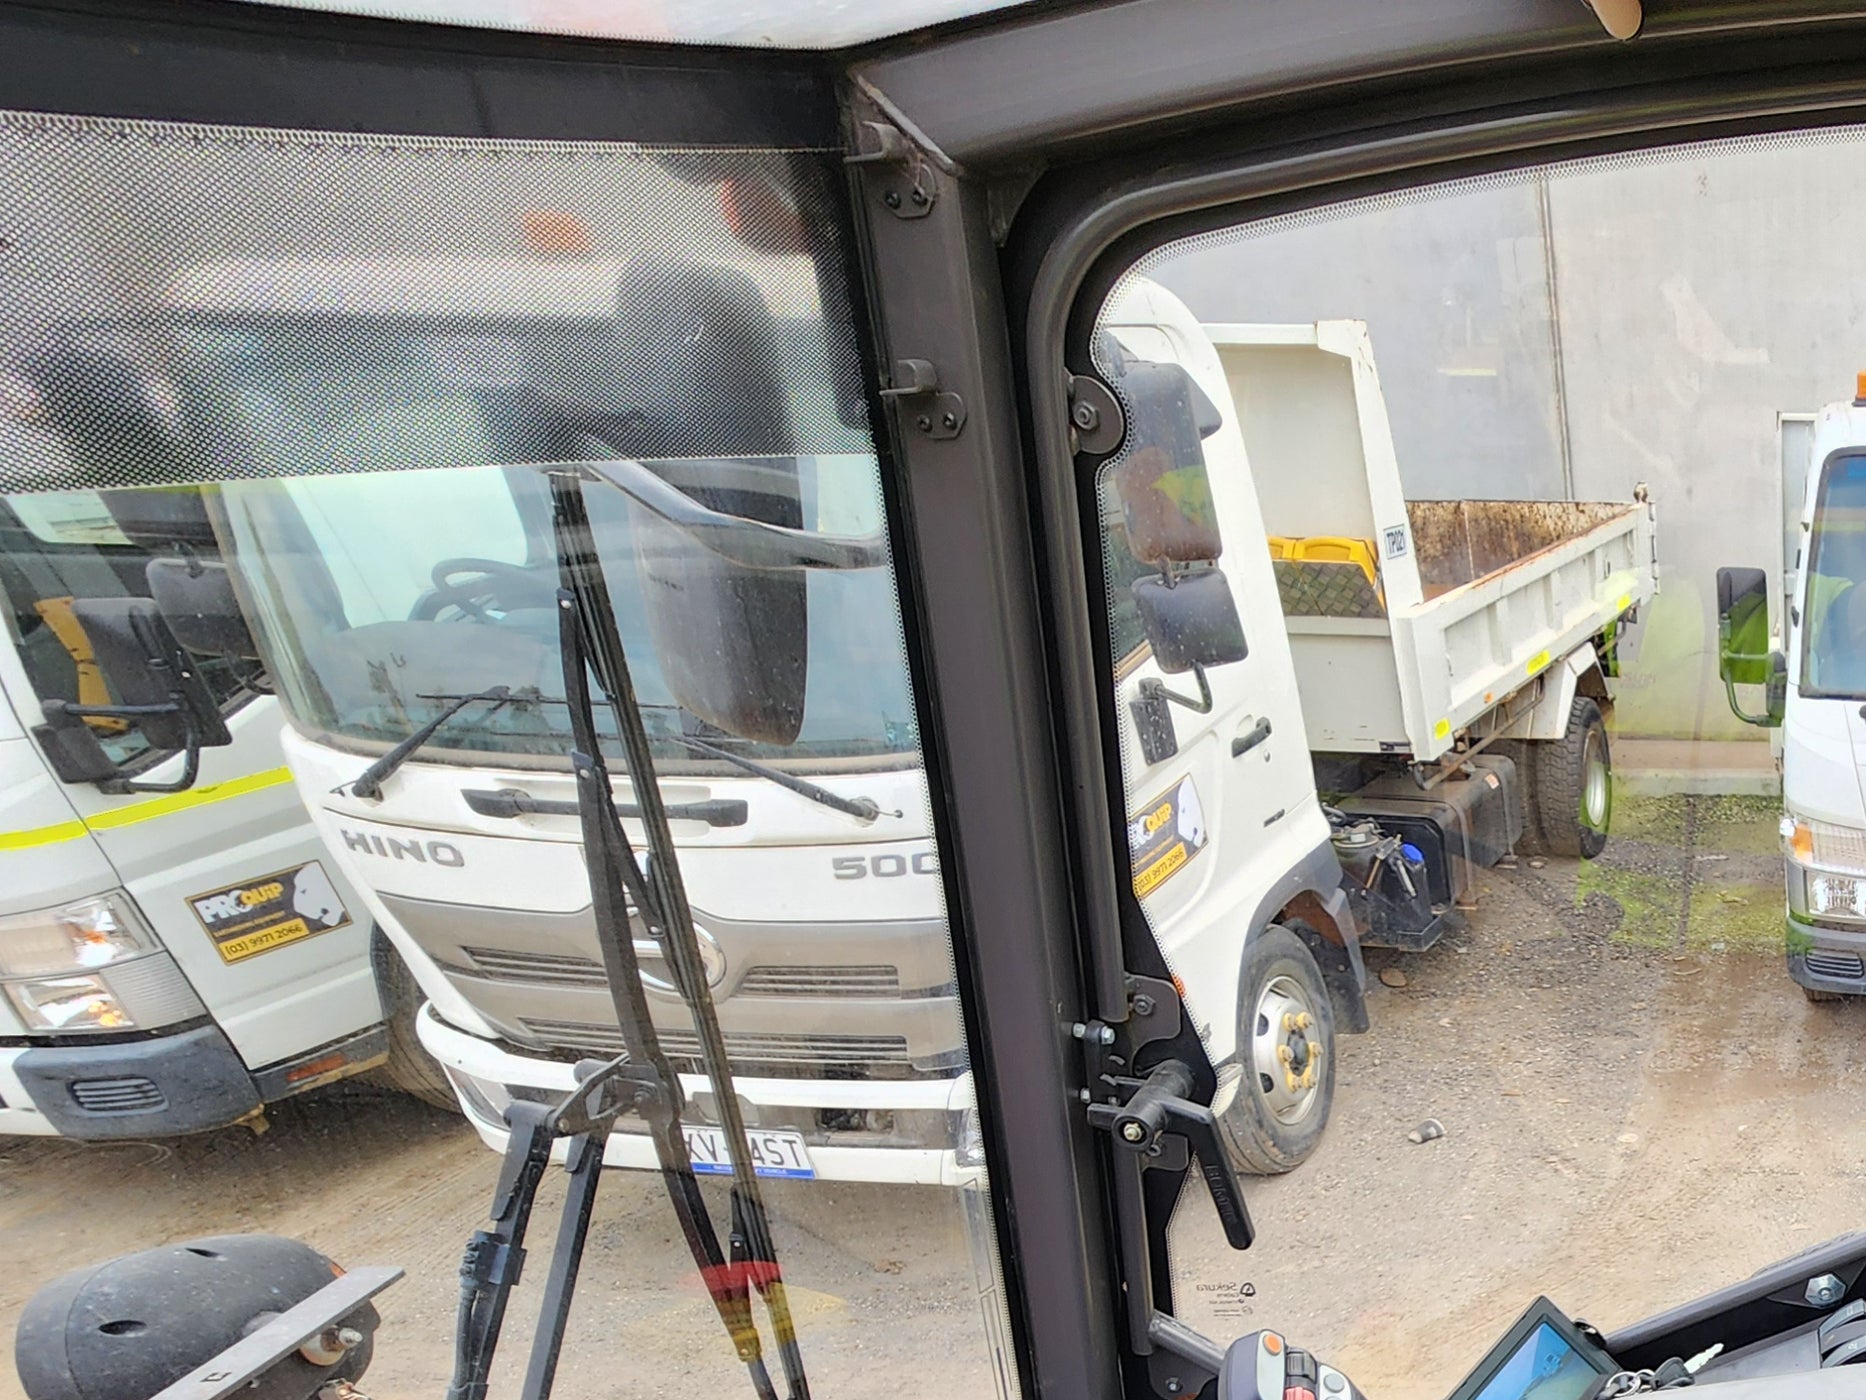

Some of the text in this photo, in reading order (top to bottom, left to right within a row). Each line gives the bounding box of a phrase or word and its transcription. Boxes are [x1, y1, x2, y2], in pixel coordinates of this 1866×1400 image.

[340, 828, 465, 868] HINO
[225, 939, 249, 956] (03)
[250, 929, 276, 947] 9971
